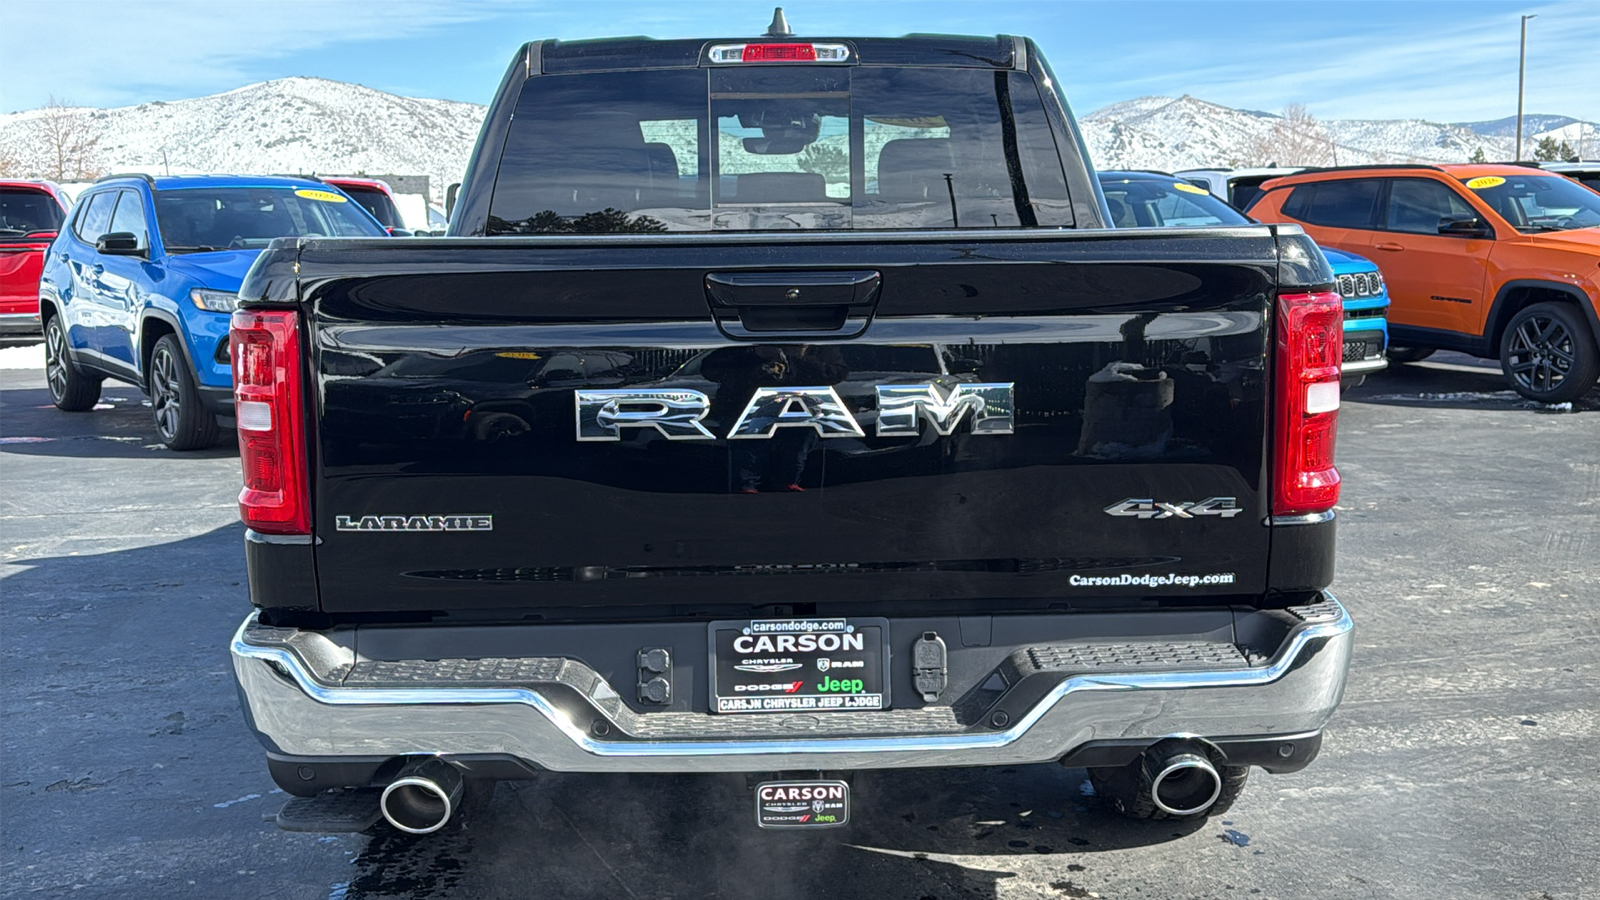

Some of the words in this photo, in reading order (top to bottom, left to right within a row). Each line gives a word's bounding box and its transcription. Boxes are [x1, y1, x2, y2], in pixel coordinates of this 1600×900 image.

[574, 382, 1015, 442] RAM
[335, 514, 493, 532] LARAMIE
[1069, 573, 1234, 587] CarsonDodgeJeep.com
[753, 620, 844, 632] carsondodge.com
[733, 633, 864, 653] CARSON
[734, 682, 794, 692] DODGE
[817, 676, 863, 694] Jeep
[763, 698, 816, 708] CHRYSLER
[817, 697, 843, 707] JEEP
[761, 787, 843, 800] CARSON
[814, 814, 836, 822] Jeep
